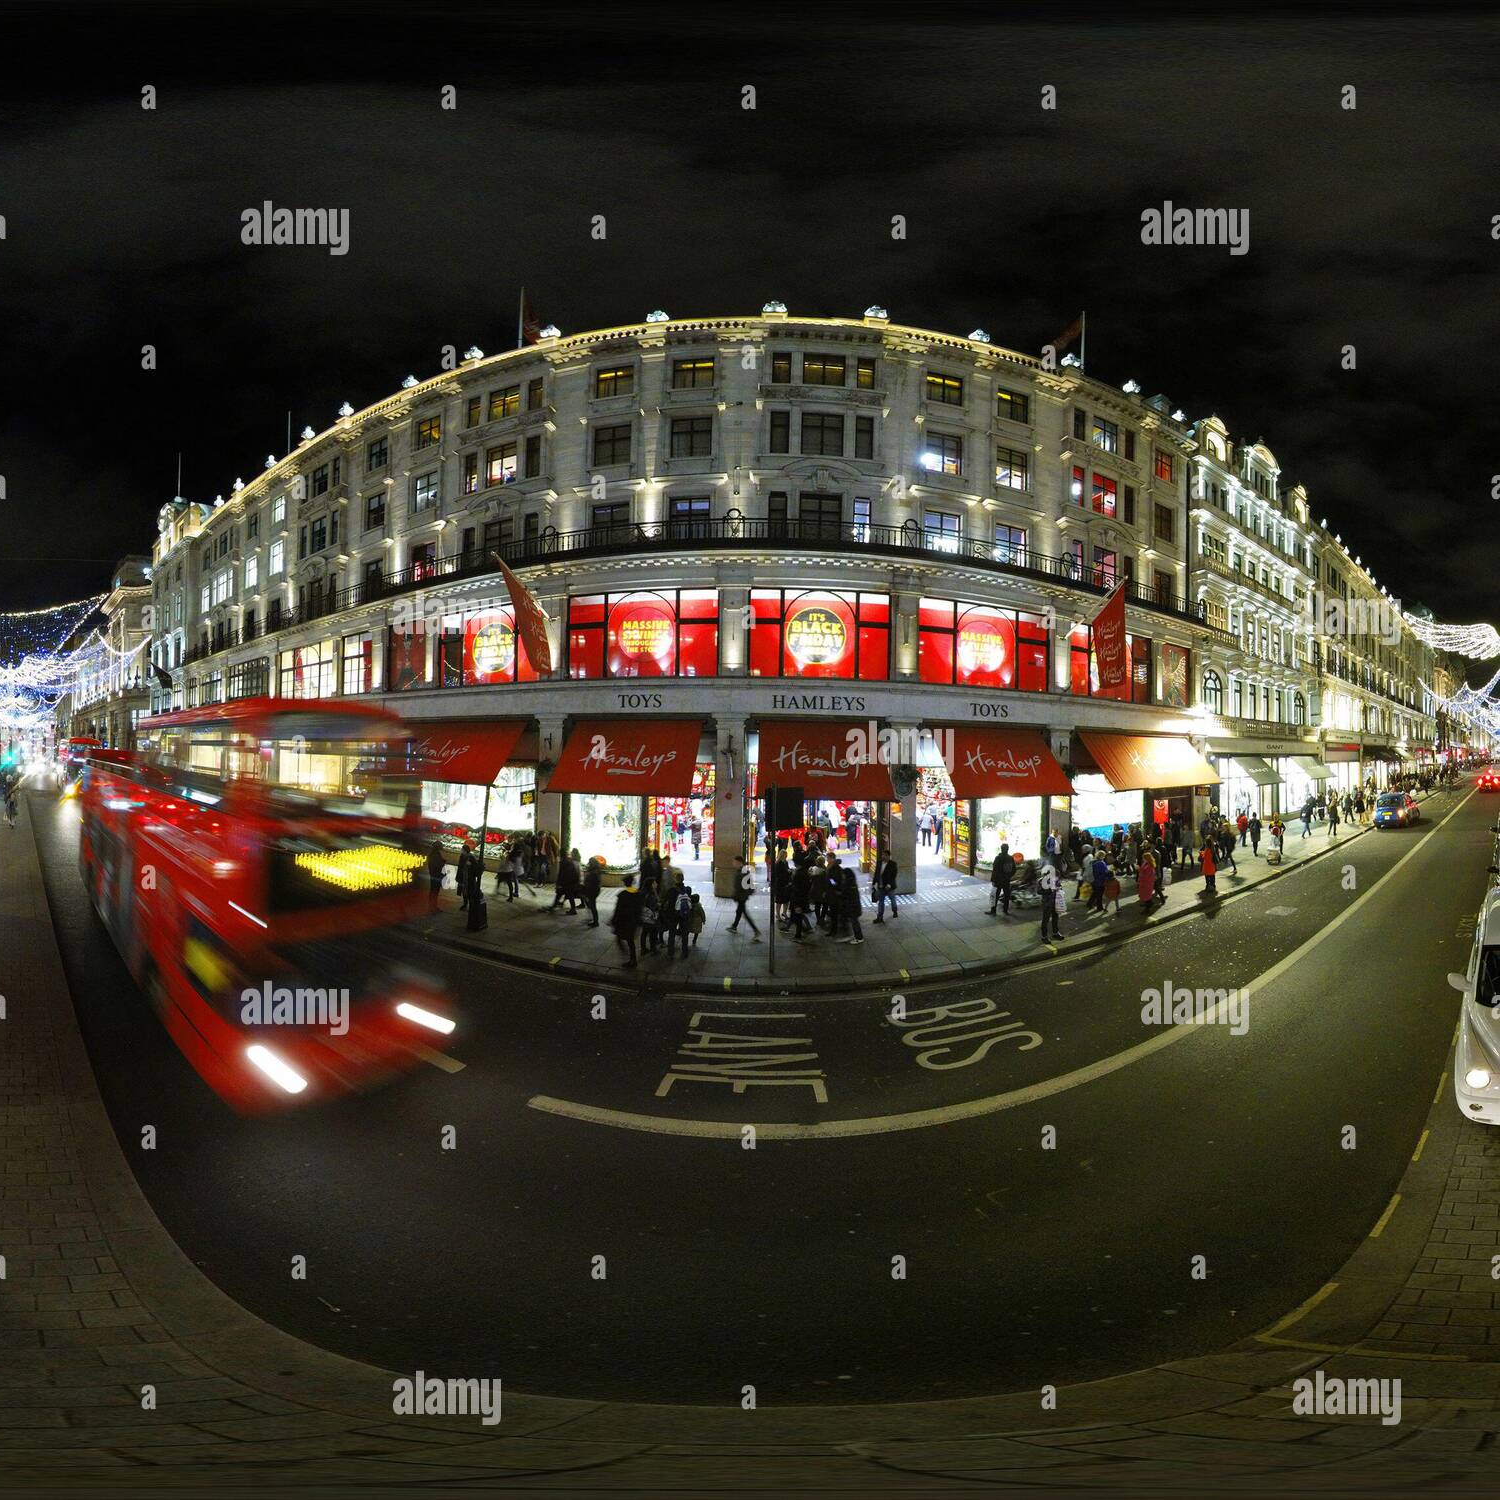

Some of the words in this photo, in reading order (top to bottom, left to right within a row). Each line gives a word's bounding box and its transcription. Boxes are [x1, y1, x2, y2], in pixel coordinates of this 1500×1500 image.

[808, 613, 826, 621] IT'S
[622, 620, 670, 630] MASSIVE
[791, 620, 842, 634] BLACK
[475, 633, 513, 647] BLACK
[789, 633, 844, 647] FRIDAY
[618, 694, 662, 708] TOYS
[772, 695, 865, 711] HAMLEYS
[970, 703, 1009, 718] TOYS
[579, 740, 677, 777] Hamleys
[772, 740, 874, 779] Hamleys
[964, 744, 1042, 778] Hamleys
[886, 998, 1043, 1071] BUS
[655, 1012, 829, 1103] LANE
